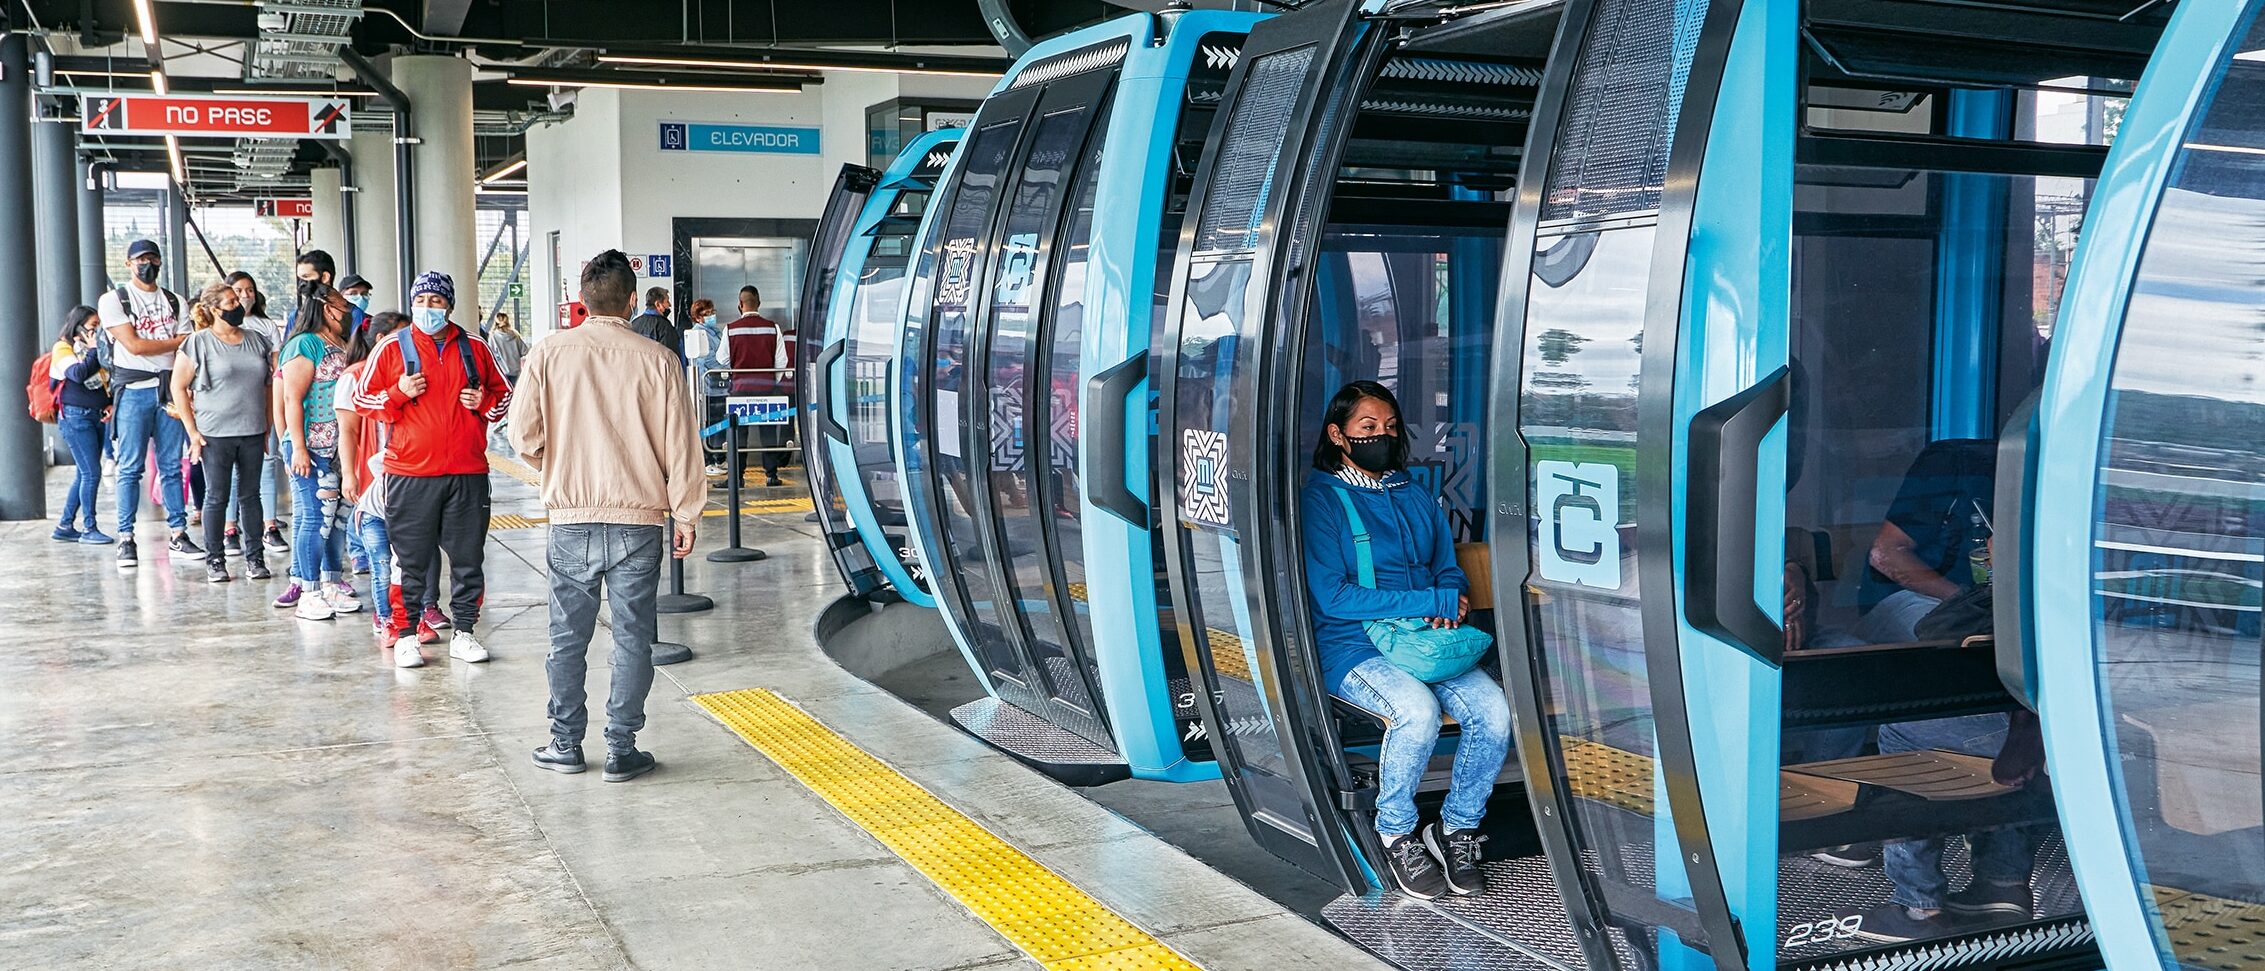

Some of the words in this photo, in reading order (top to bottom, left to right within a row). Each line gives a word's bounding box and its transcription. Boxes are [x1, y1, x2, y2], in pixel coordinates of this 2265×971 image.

[166, 106, 199, 124] NO
[208, 107, 272, 125] PASE
[711, 131, 799, 147] ELEVADOR
[295, 203, 313, 213] NO
[1784, 914, 1863, 948] 239
